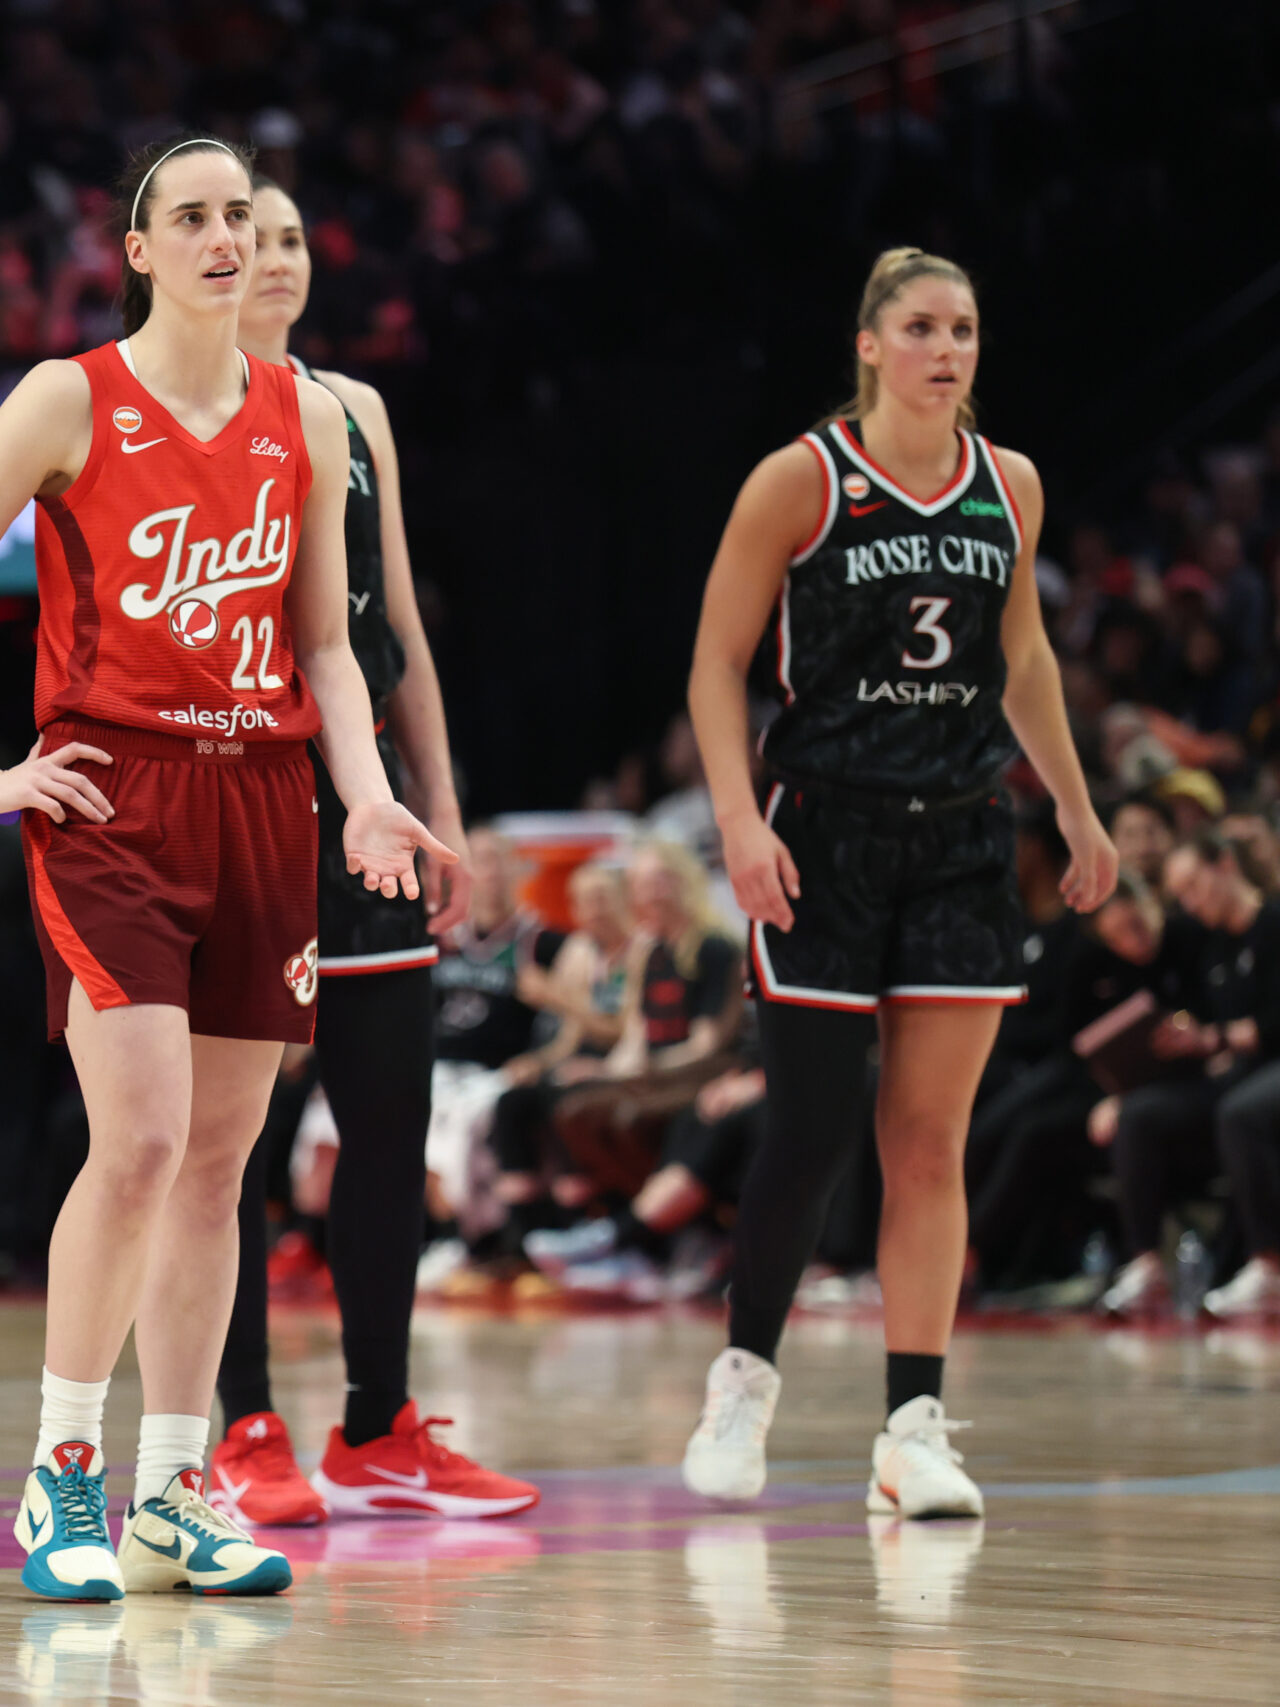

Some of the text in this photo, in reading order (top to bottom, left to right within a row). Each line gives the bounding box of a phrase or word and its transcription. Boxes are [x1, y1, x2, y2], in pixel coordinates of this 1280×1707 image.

[249, 436, 290, 464] Lilly
[119, 478, 292, 620] Indy
[844, 534, 1010, 588] ROSE CITY
[230, 615, 285, 691] 22
[901, 595, 954, 670] 3
[856, 677, 979, 708] LASHIFY
[196, 741, 244, 755] TO WIN
